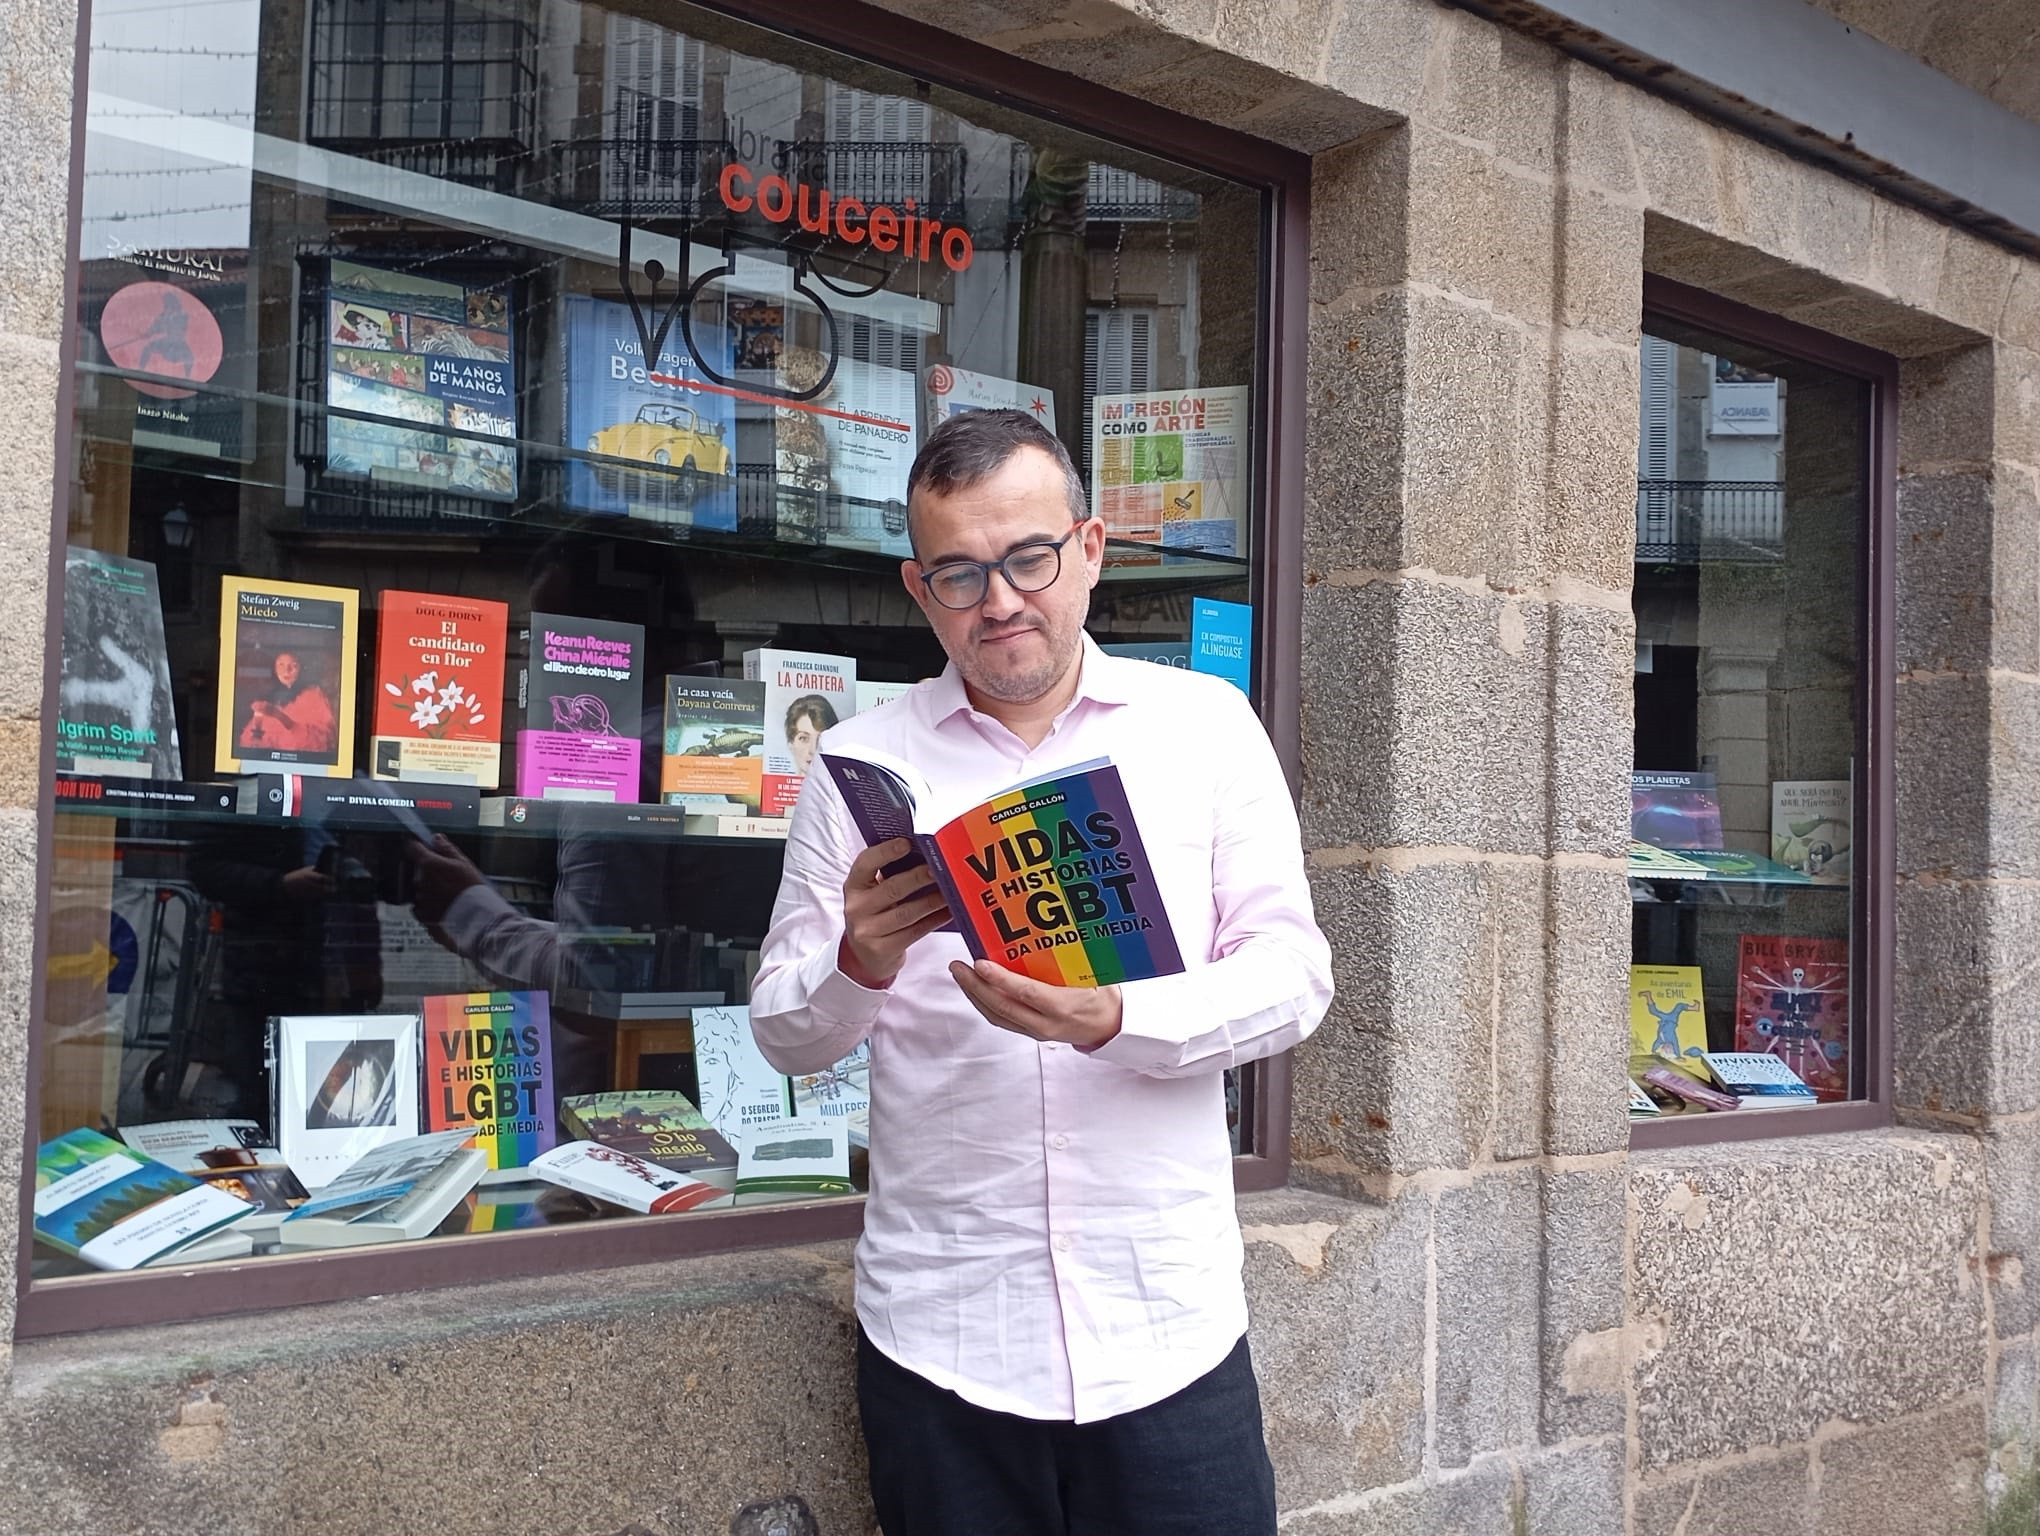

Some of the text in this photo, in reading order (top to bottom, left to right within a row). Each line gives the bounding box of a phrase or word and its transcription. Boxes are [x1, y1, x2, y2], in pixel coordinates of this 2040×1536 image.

[719, 163, 974, 272] couceiro
[106, 235, 223, 272] SAMURAI
[615, 339, 697, 368] Volkagen
[433, 360, 502, 383] MIL AÑOS
[429, 371, 507, 396] DE MANGA
[1102, 395, 1206, 420] IMPRESIÓN
[838, 420, 909, 444] DE PANADERO
[1102, 414, 1206, 435] COMO ARTE
[241, 593, 300, 611] Stefan Zweig
[241, 605, 278, 618] Miedo
[416, 607, 484, 622] DOUG DORST
[441, 621, 457, 635] El
[408, 636, 486, 654] candidato
[544, 631, 632, 654] Keanu Reeves
[421, 651, 473, 668] en flor
[544, 646, 631, 669] China Miéville
[782, 660, 840, 674] FRANCESCA GIANNONE
[678, 686, 734, 699] La casa vacía
[778, 671, 845, 693] LA CARTERA
[677, 698, 756, 712] Dayana Contreras
[57, 717, 157, 745] ilgrim Spirit
[79, 781, 102, 799] VITO
[1645, 775, 1691, 785] PLANETAS
[377, 797, 415, 807] COMEDIA
[990, 793, 1066, 823] CARLOS CALLÓN
[964, 811, 1123, 885] VIDAS
[979, 850, 1132, 908] E HISTORIAS
[990, 872, 1138, 945] LGBT
[1006, 916, 1154, 962] DA IDADE MEDIA
[1744, 942, 1778, 957] BILL
[1665, 989, 1687, 999] EMIL
[464, 1005, 514, 1014] CARLOS CALLÓN
[439, 1025, 541, 1062] VIDAS
[441, 1061, 542, 1083] E HISTORIAS
[443, 1080, 543, 1123] LGBT
[741, 1103, 780, 1116] O SEGREDO
[507, 1120, 545, 1134] MEDIA
[649, 1142, 707, 1155] vasalo
[653, 1132, 697, 1145] O bo
